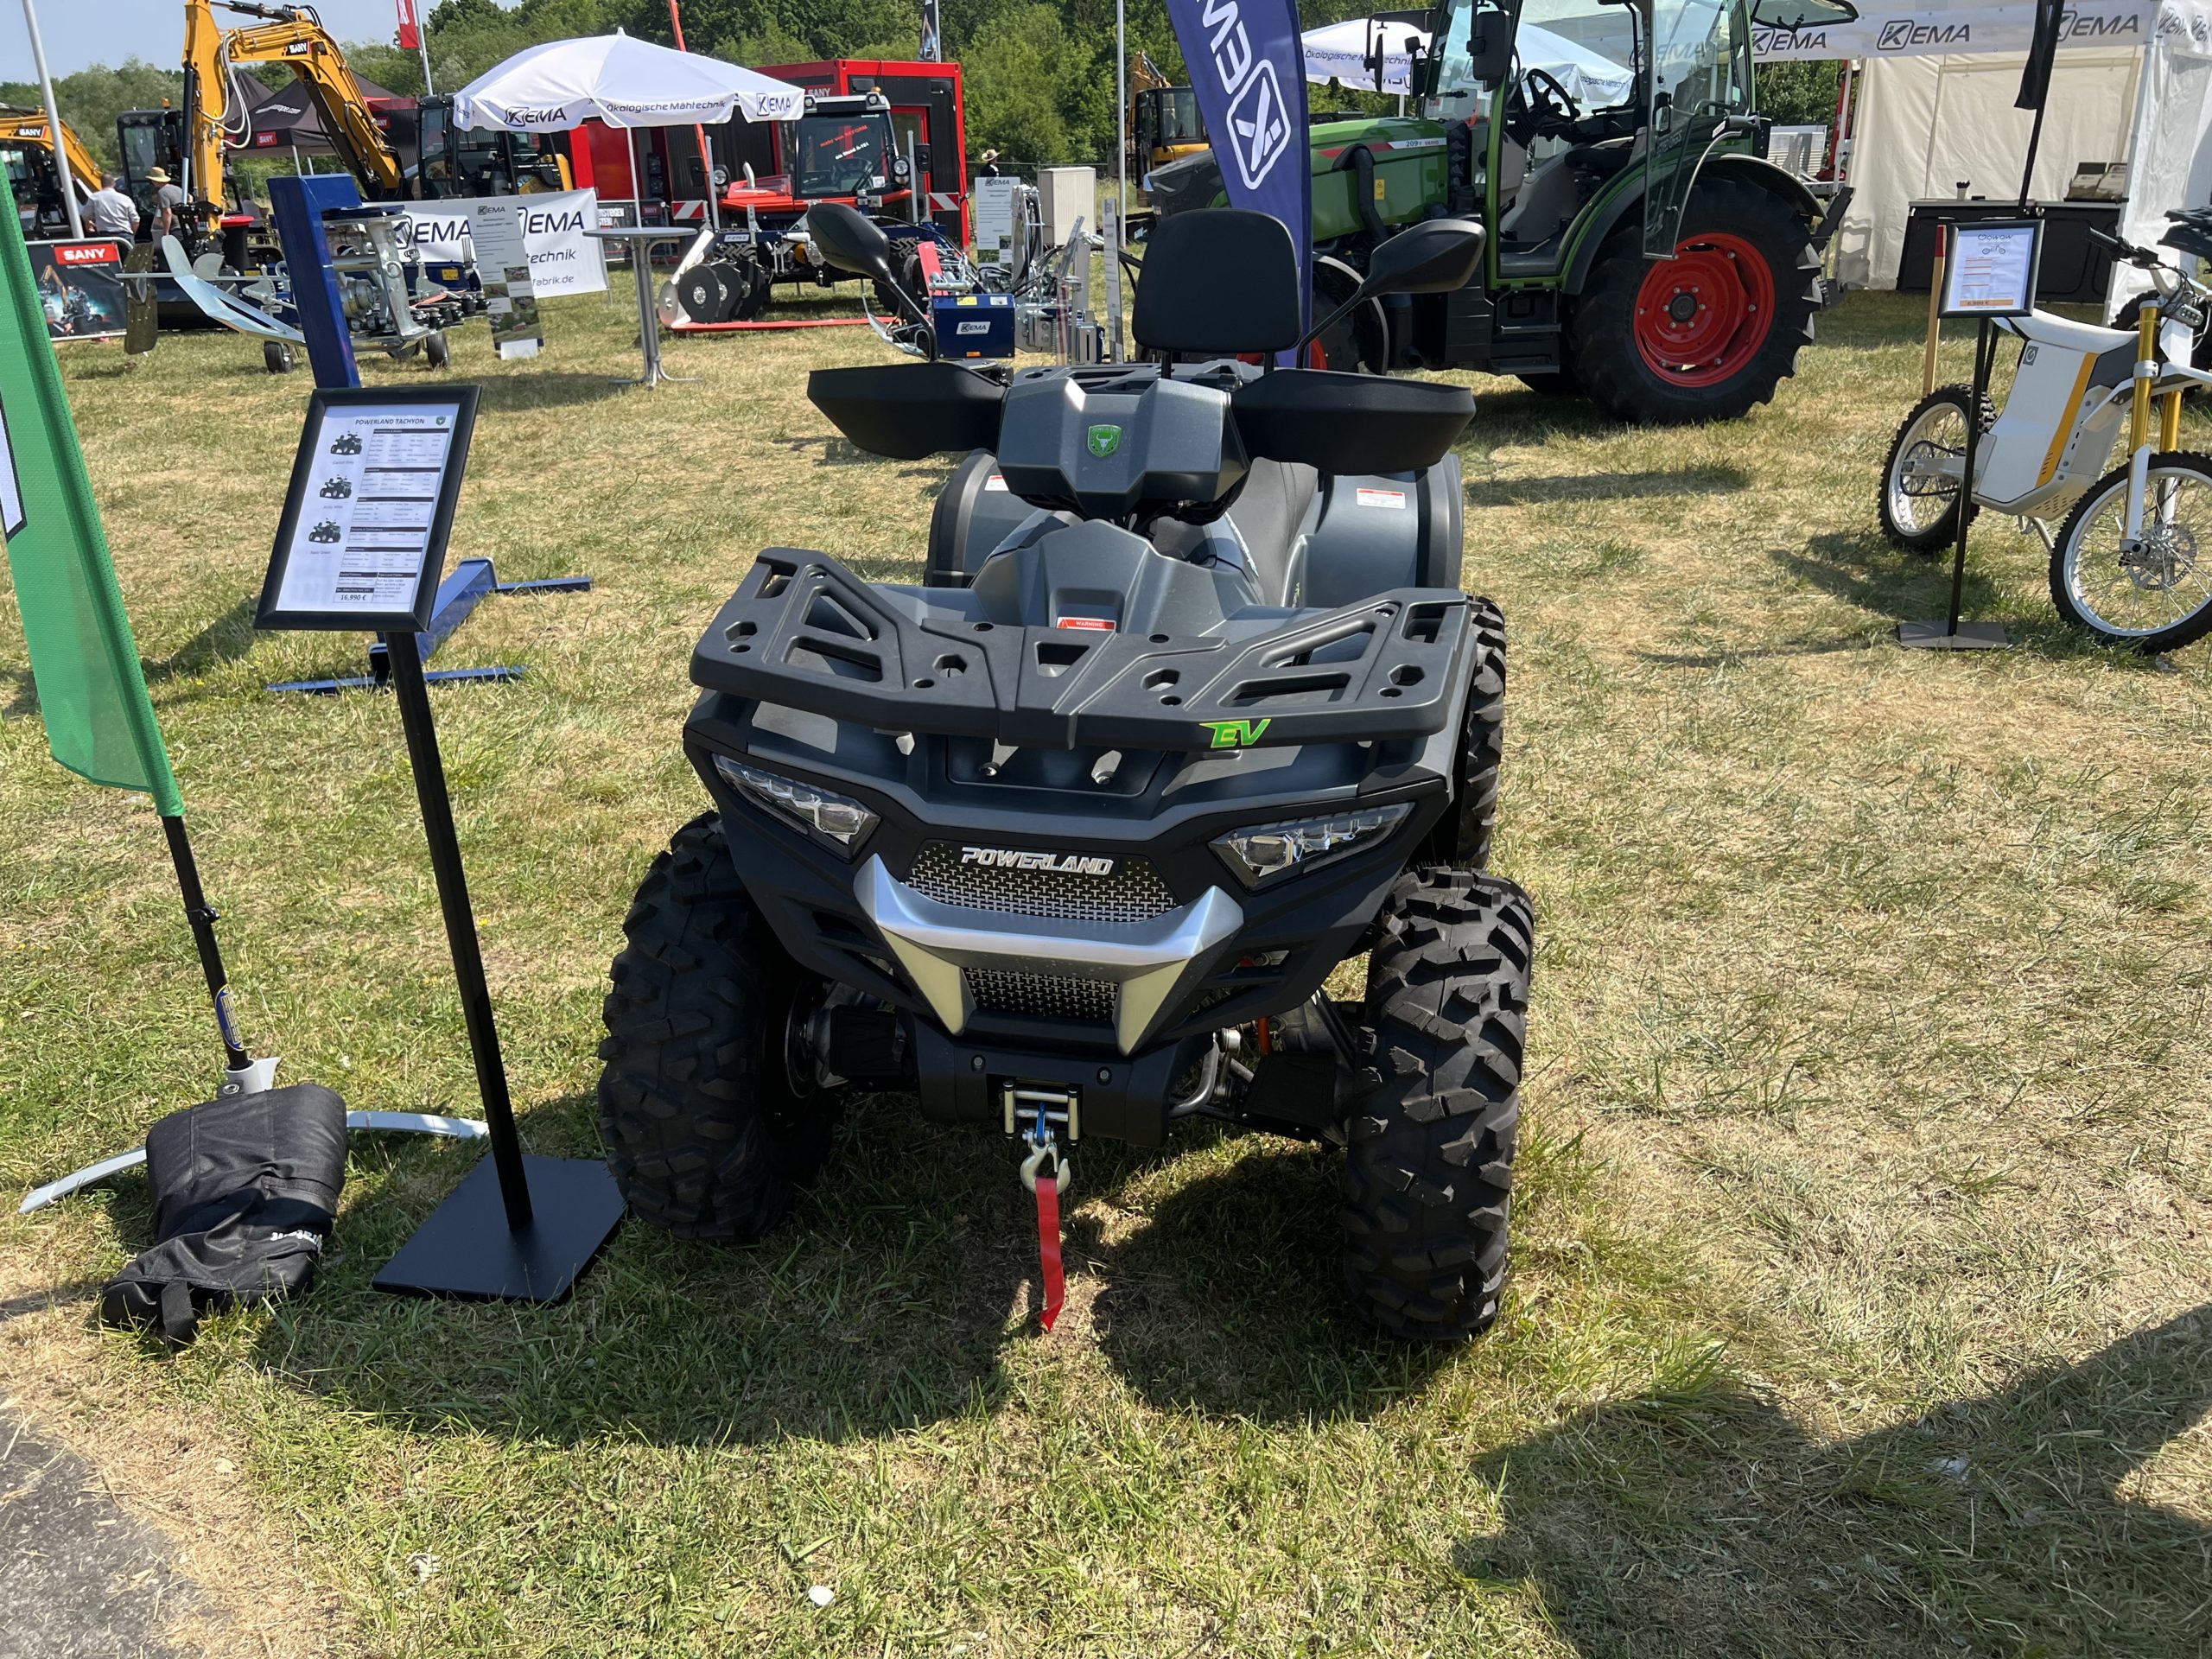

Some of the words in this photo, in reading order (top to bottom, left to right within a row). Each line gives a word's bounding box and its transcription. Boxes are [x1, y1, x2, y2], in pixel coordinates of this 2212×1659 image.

[1751, 29, 1827, 55] KEMA
[1877, 20, 1970, 50] KEMA
[289, 42, 308, 54] SANY
[1305, 49, 1357, 61] Ökologische
[807, 88, 831, 97] SANY
[1198, 0, 1291, 189] KEM
[607, 102, 668, 113] Ökologische
[669, 99, 727, 111] Mähtechnik
[755, 92, 791, 116] KEMA
[504, 106, 567, 127] KEMA
[19, 128, 41, 137] SANY
[259, 135, 274, 143] SANY
[477, 206, 505, 215] KEMA
[401, 216, 473, 246] EMA
[63, 248, 105, 261] SANY
[526, 248, 576, 264] technik
[532, 275, 574, 287] fabrik.de
[960, 323, 987, 333] KEMA
[1198, 718, 1272, 748] EV
[961, 847, 1115, 875] POWERLAND
